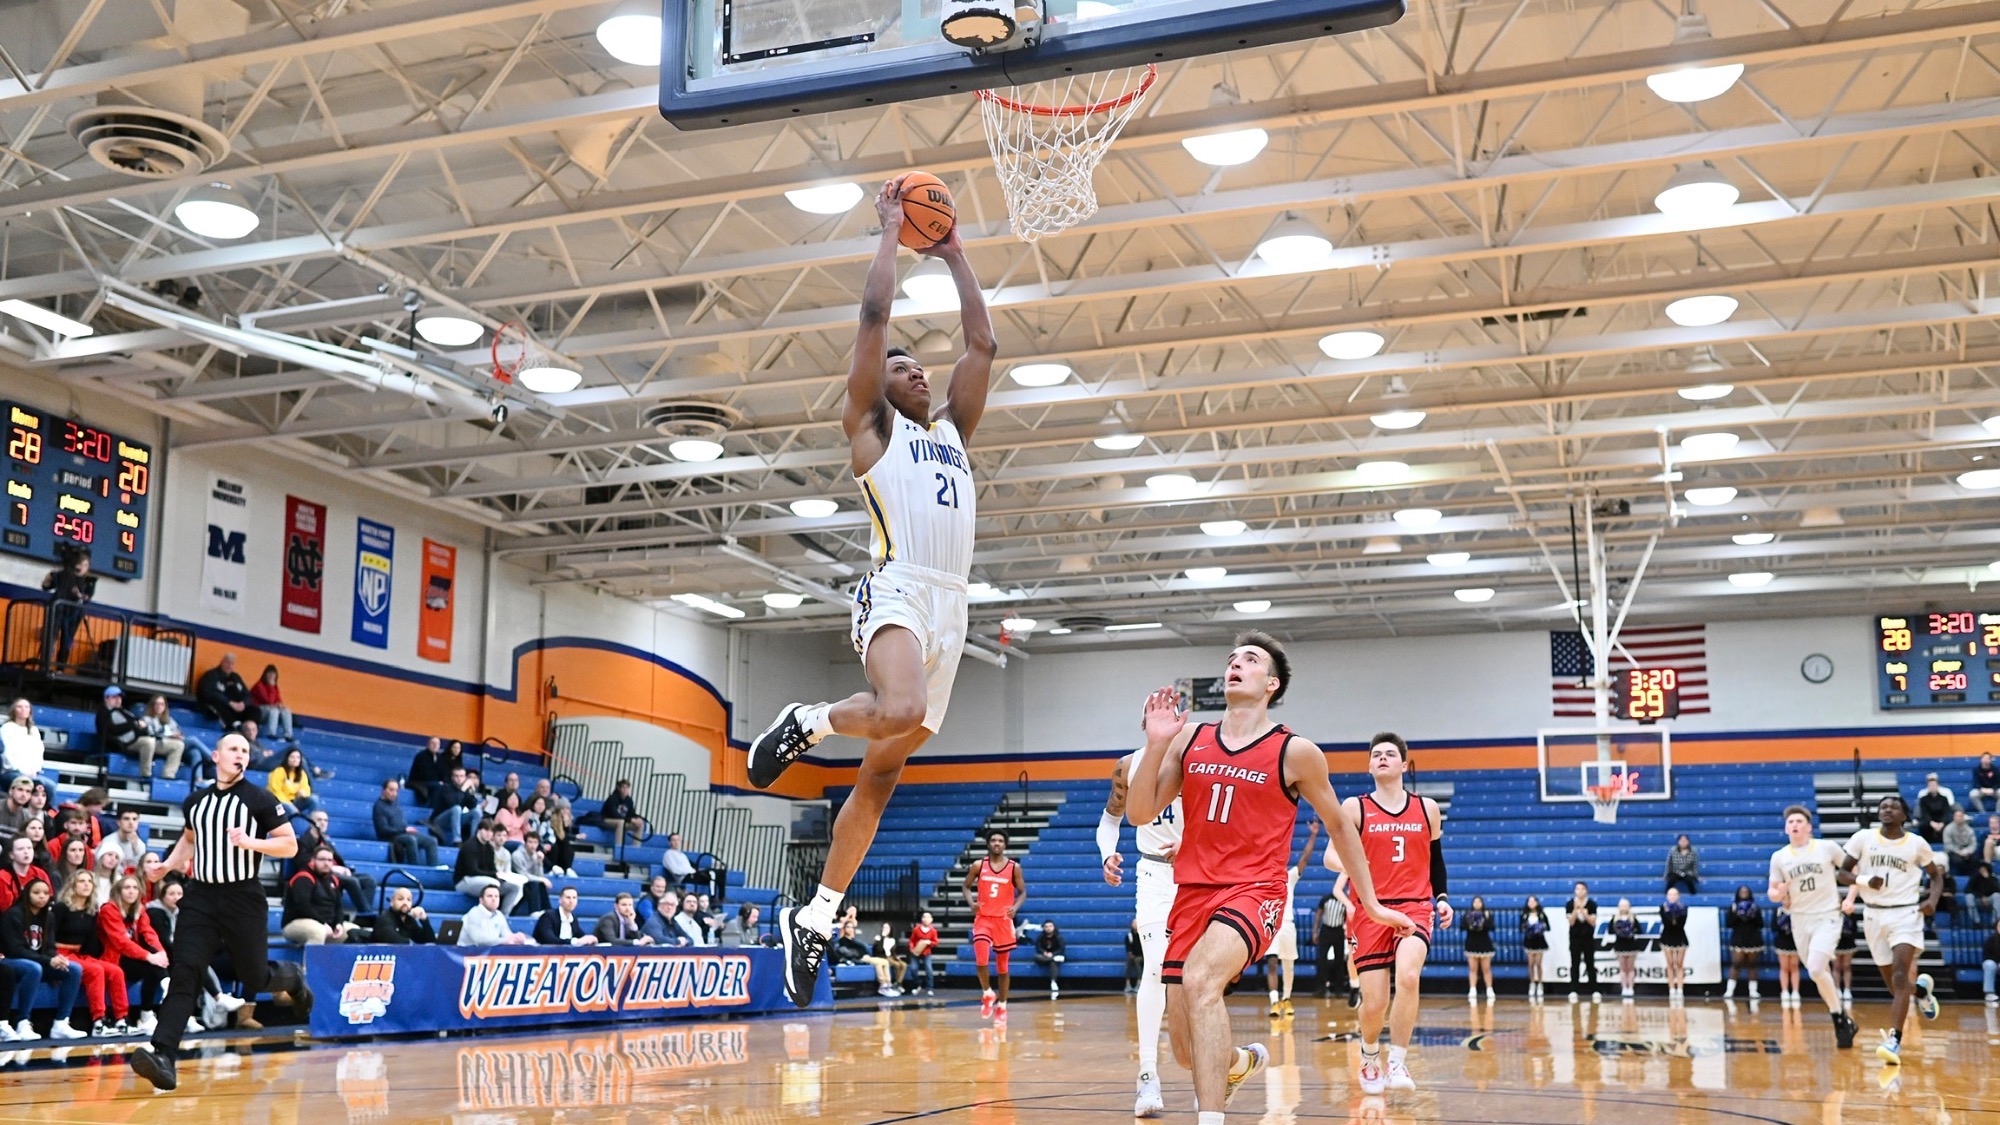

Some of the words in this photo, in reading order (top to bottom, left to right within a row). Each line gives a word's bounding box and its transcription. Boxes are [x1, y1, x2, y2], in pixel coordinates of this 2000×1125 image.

[9, 427, 42, 465] 28
[64, 421, 112, 463] 3:20
[909, 439, 969, 476] VIKINGS
[63, 471, 93, 490] period
[102, 478, 109, 498] 1
[118, 461, 148, 495] 20
[935, 472, 959, 509] 21
[16, 502, 28, 526] 7
[53, 513, 94, 544] 2-50
[121, 531, 135, 553] 4
[208, 523, 247, 565] M
[362, 567, 387, 611] NP
[1929, 612, 1975, 635] 3:20
[1882, 628, 1912, 651] 28
[1969, 641, 1977, 656] 1
[1630, 669, 1676, 691] 3:20
[1894, 675, 1907, 691] 7
[1929, 673, 1967, 691] 2-50
[1629, 689, 1664, 718] 29
[1188, 762, 1269, 785] CARTHAGE
[1206, 782, 1236, 825] 11
[1368, 822, 1423, 833] CARTHAGE
[1391, 835, 1405, 863] 3
[1788, 862, 1823, 880] VIKINGS
[1870, 854, 1909, 873] VIKINGS
[989, 883, 999, 899] 5
[1799, 876, 1816, 893] 20
[460, 958, 629, 1013] WHEATON
[626, 957, 750, 1003] THUNDER
